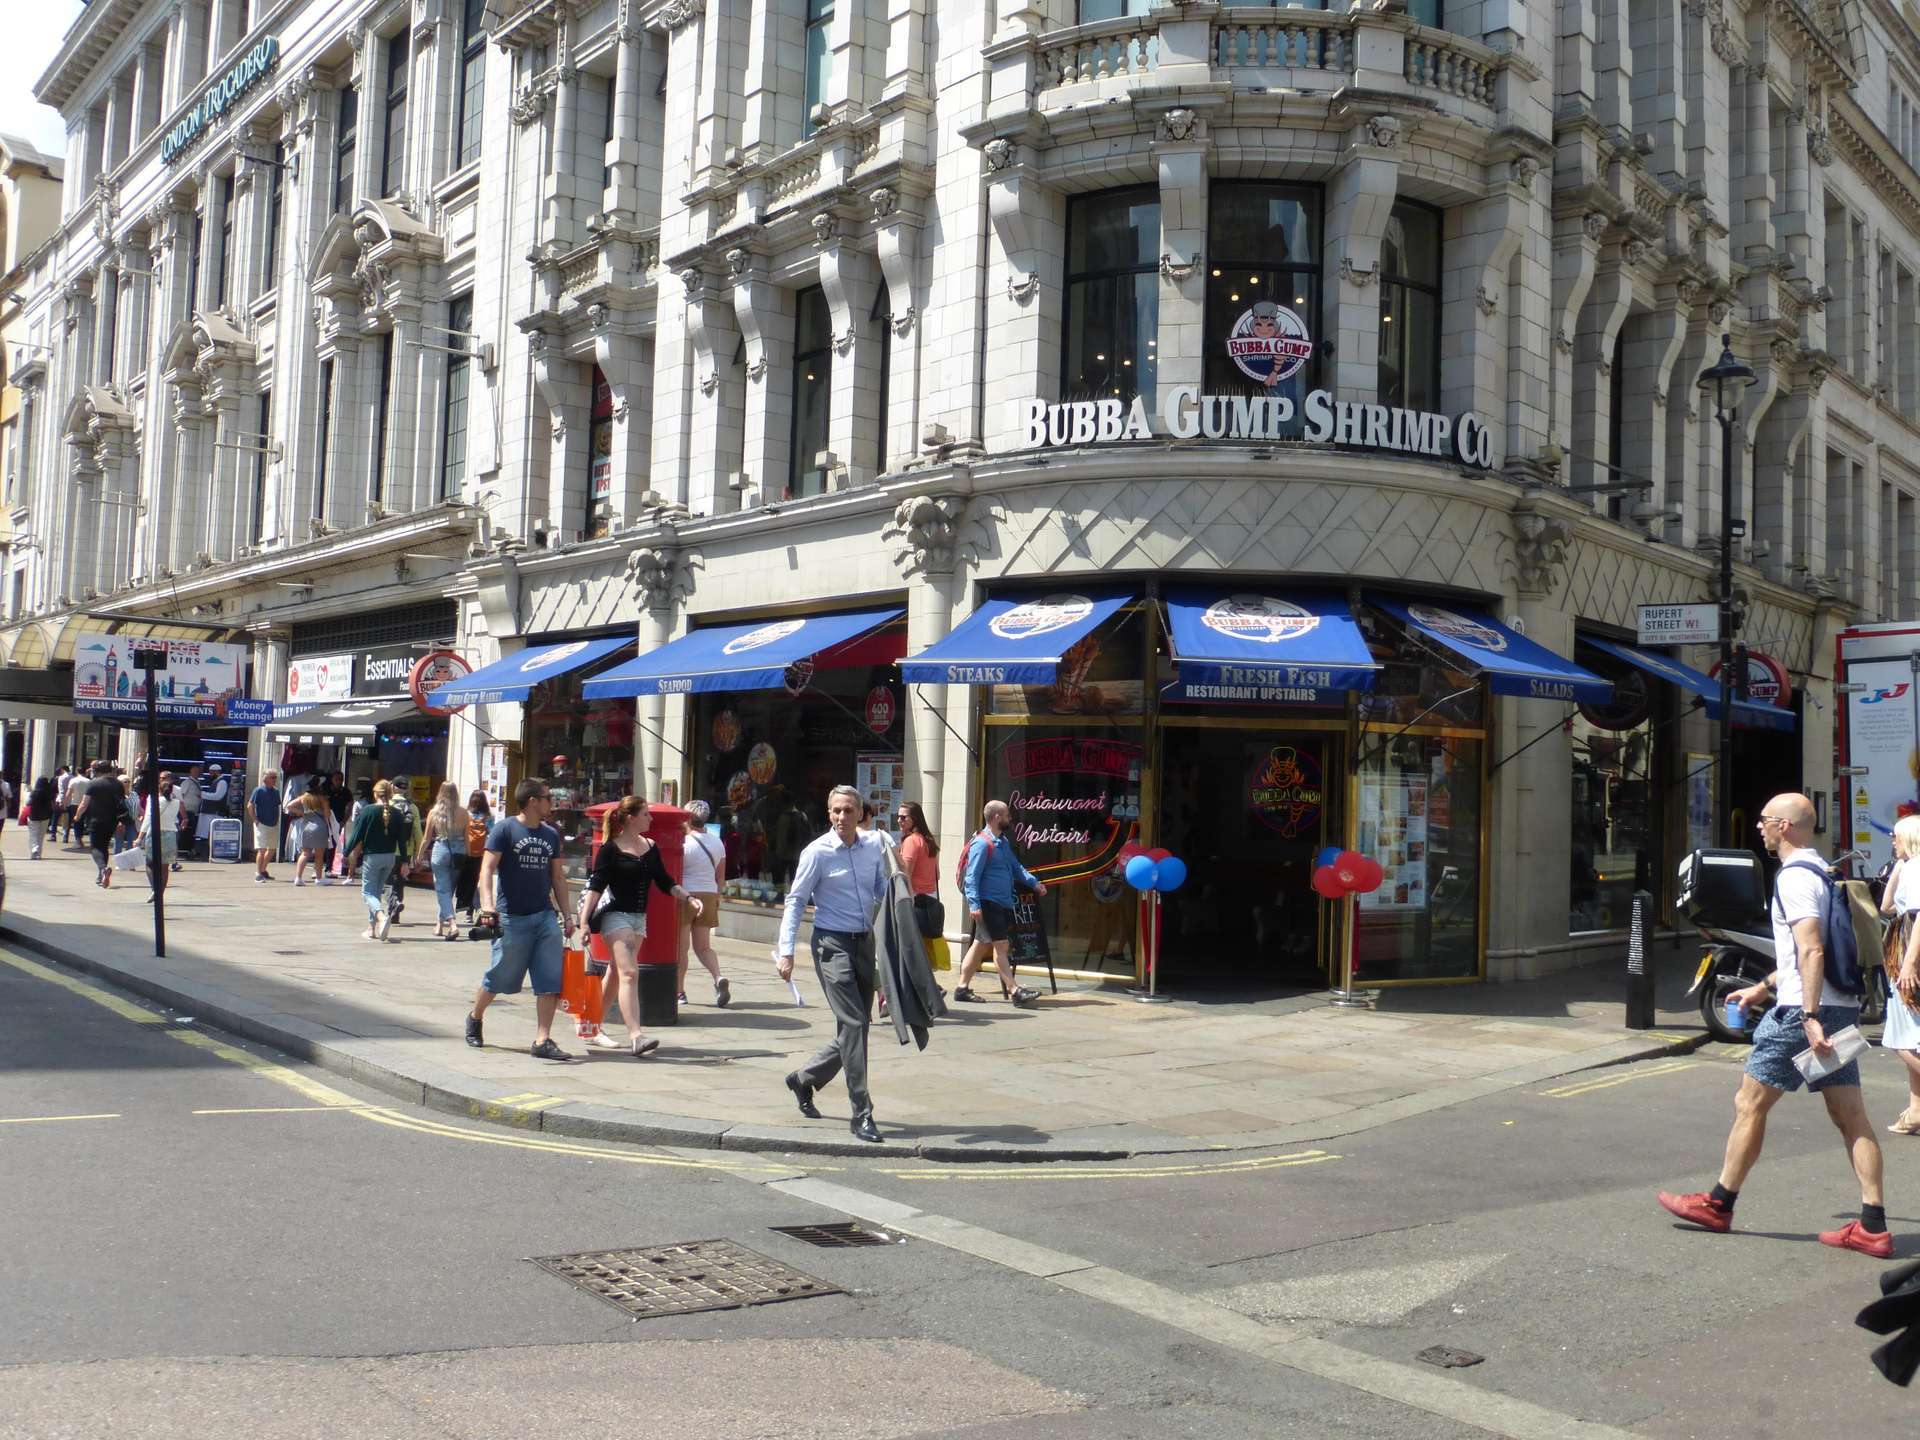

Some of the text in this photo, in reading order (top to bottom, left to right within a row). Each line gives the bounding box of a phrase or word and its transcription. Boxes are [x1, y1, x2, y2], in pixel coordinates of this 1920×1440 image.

[160, 35, 277, 164] LONDON TROCADERO
[1229, 339, 1311, 356] BUBBA GUMP
[1242, 354, 1273, 362] SHRIMP
[1023, 395, 1153, 448] BUBBA
[1164, 385, 1294, 440] GUMP
[1304, 389, 1451, 456] SHRIMP
[1206, 616, 1319, 627] BUBBA GUMP
[1645, 608, 1683, 619] RUPERT
[1645, 620, 1681, 630] STREET
[128, 653, 201, 665] SNIRS
[365, 654, 415, 681] ESSENTIALS
[947, 665, 1004, 682] STEAKS
[1219, 665, 1331, 687] FRESH FISH
[658, 679, 693, 694] SEAFOOD
[1186, 684, 1317, 701] RESTAURANT UPSTAIRS
[1530, 679, 1574, 698] SALADS
[75, 700, 214, 716] SPECIAL DISCOUN FOR STUDENTS
[235, 700, 267, 712] Money
[871, 703, 889, 714] 400
[228, 710, 272, 722] Exchange
[1009, 790, 1107, 810] Restaurant
[1015, 822, 1090, 849] Upstairs
[529, 846, 542, 854] AND
[520, 854, 539, 863] FITCH
[1013, 903, 1036, 924] REE
